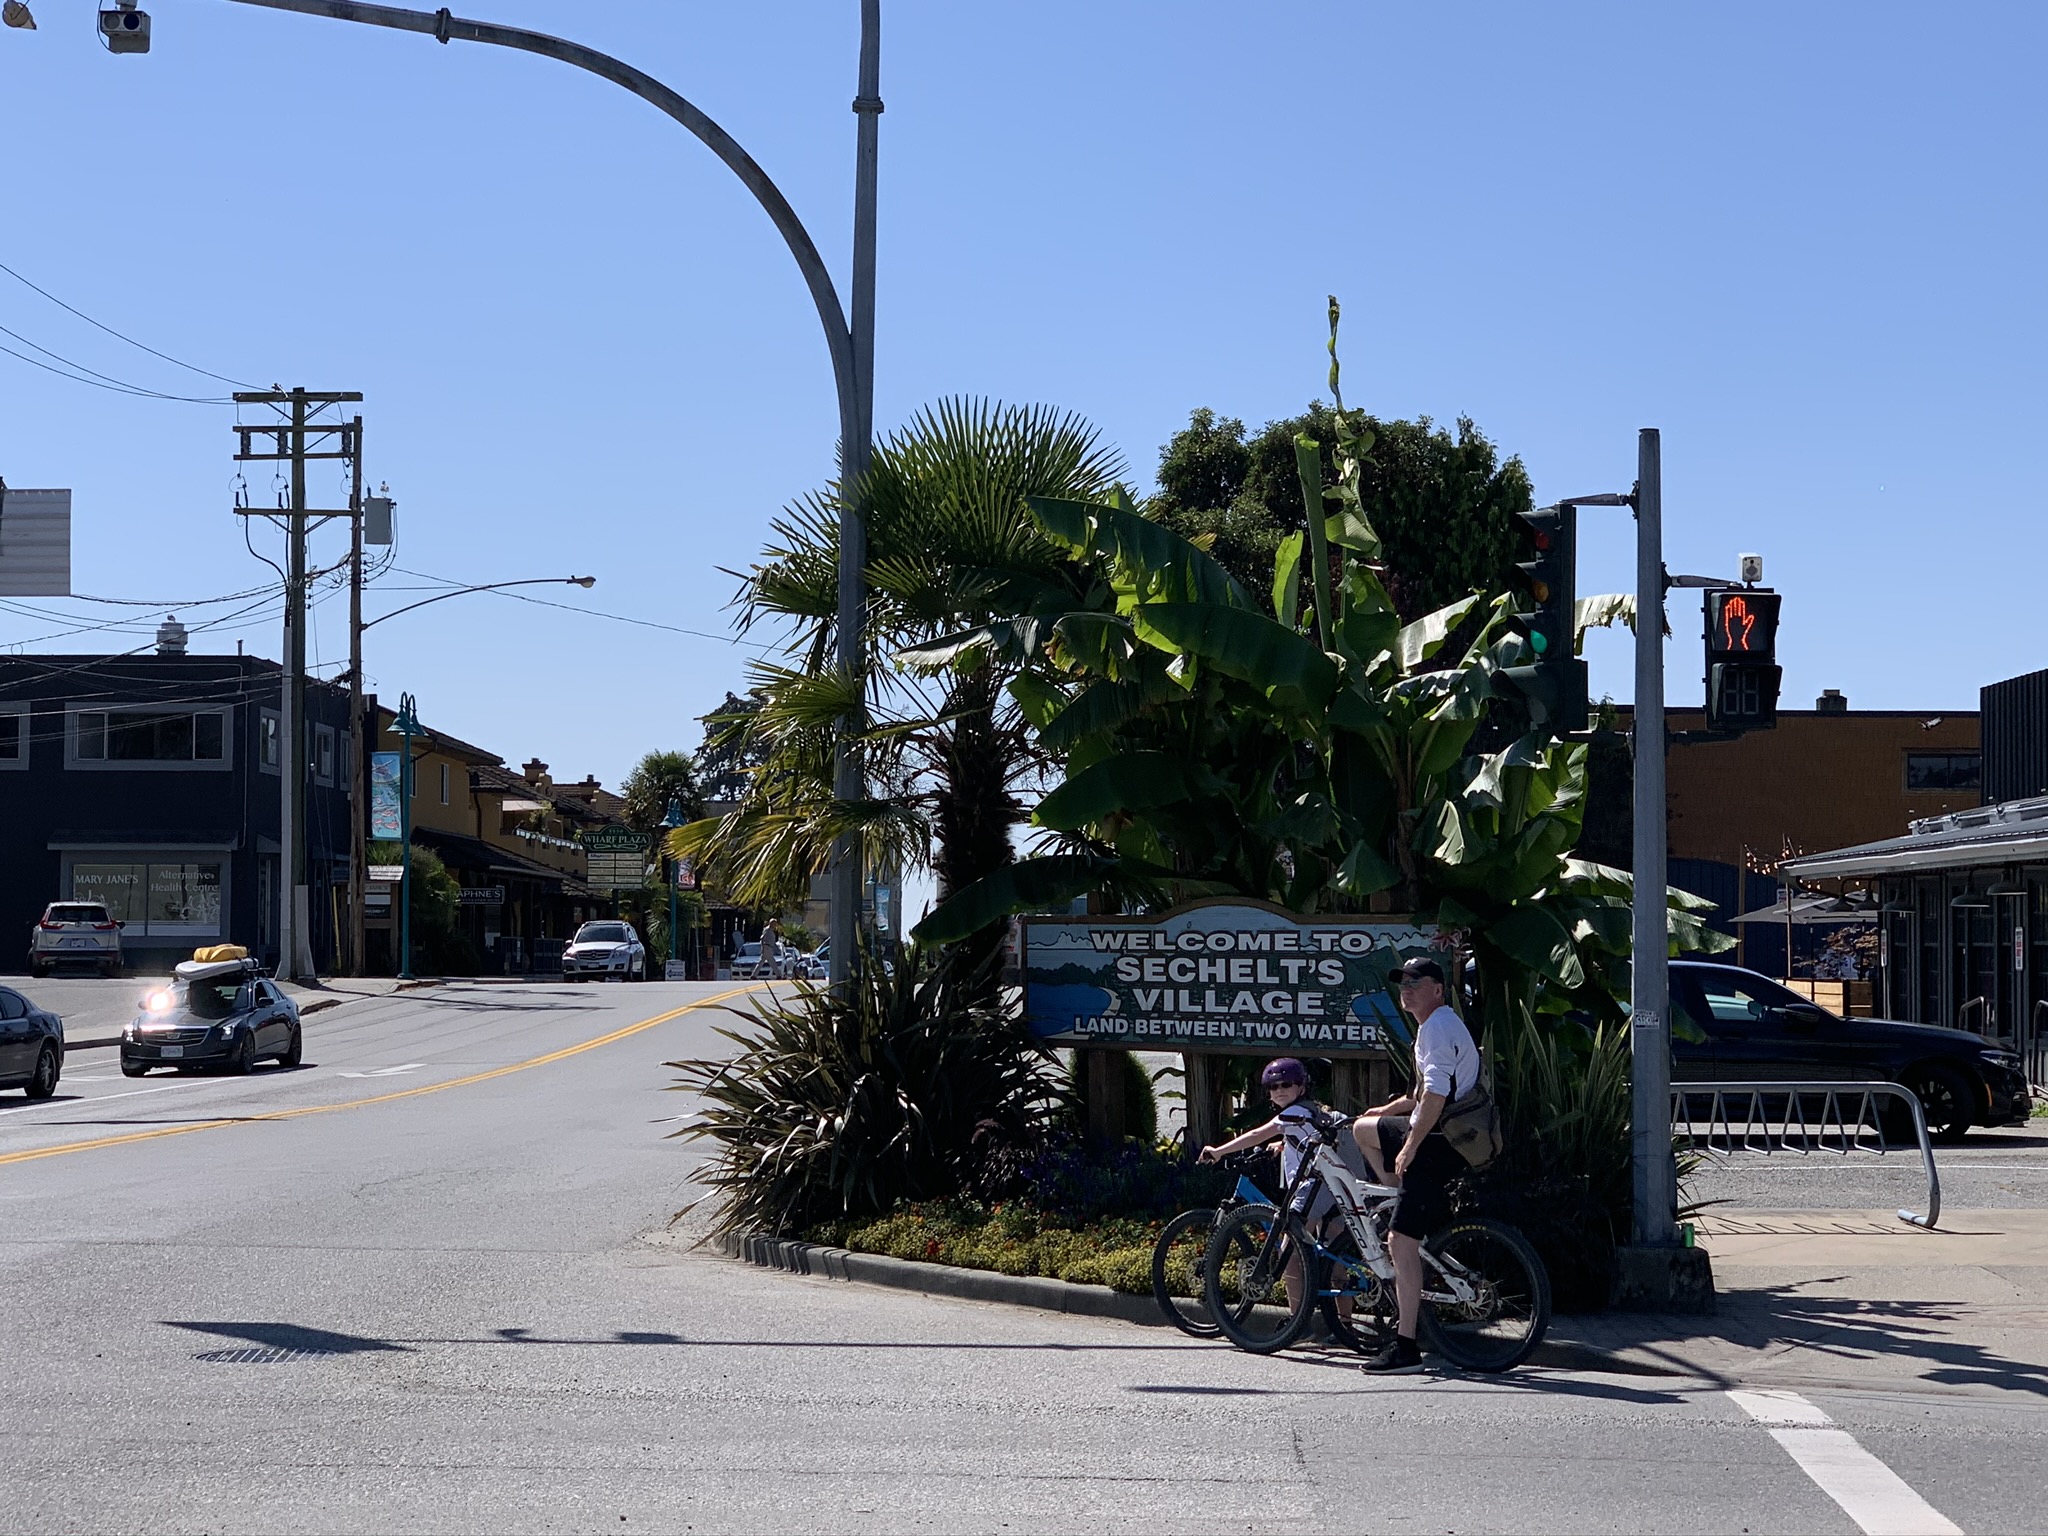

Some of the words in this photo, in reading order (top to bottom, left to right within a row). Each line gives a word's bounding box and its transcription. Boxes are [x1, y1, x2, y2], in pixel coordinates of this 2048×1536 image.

[584, 835, 617, 844] WHARF
[618, 835, 647, 844] PLAZA
[75, 875, 103, 884] MARY
[106, 875, 139, 884] JANE'S
[151, 882, 182, 892] Health
[184, 883, 218, 892] Centre
[457, 890, 501, 898] APHNE'S
[1091, 933, 1298, 951] WELCOME
[1313, 933, 1371, 952] TO
[1116, 957, 1345, 986] SECHELT'S
[1132, 988, 1324, 1015] VILLAGE
[1075, 1017, 1128, 1034] LAND
[1135, 1019, 1235, 1037] BETWEEN
[1242, 1022, 1291, 1039] TWO
